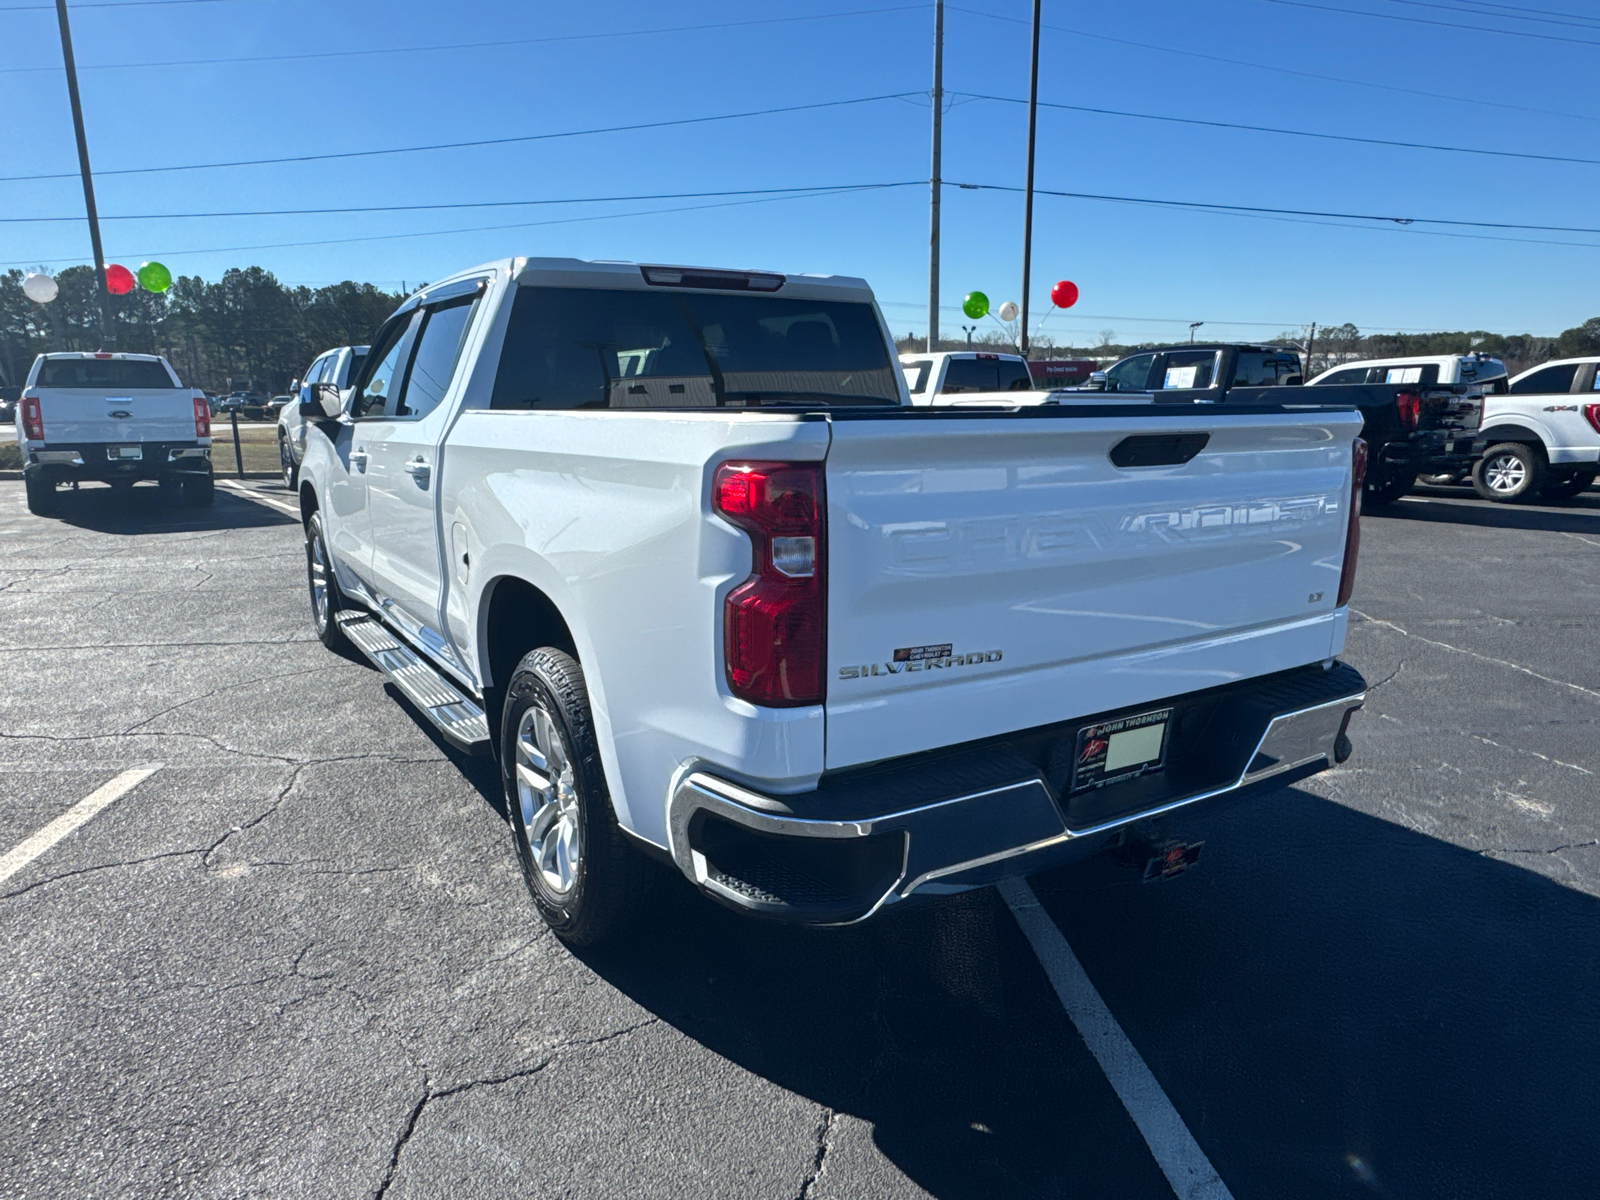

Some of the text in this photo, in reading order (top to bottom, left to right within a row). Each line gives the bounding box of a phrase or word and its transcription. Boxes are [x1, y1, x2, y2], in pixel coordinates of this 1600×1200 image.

[910, 651, 941, 660] CHEVROLET
[924, 645, 952, 653] THORNTON
[839, 649, 1003, 680] SILVERADO
[1100, 711, 1169, 734] JOHN THORNTON
